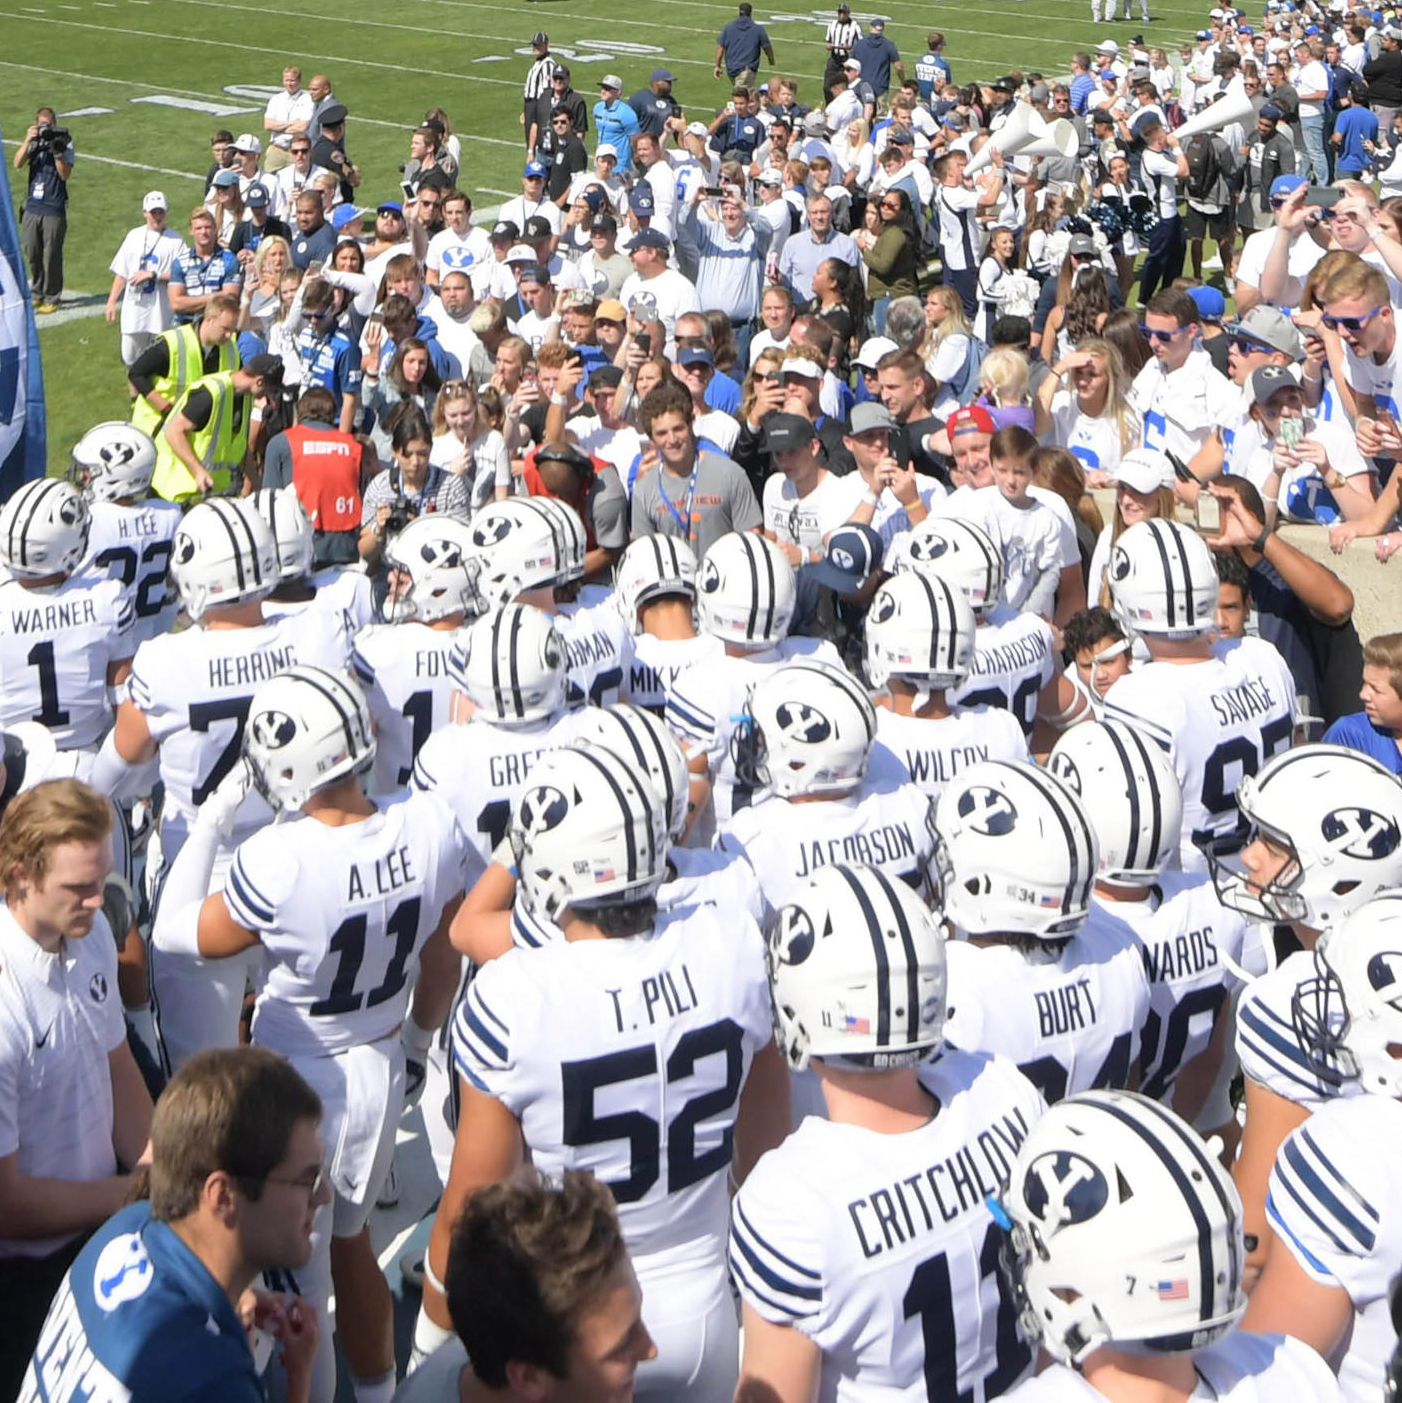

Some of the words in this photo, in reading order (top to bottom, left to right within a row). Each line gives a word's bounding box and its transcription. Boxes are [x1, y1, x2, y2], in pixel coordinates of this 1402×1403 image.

[302, 439, 350, 456] ESPN
[335, 497, 354, 514] 61
[11, 599, 97, 635] WARNER
[27, 640, 70, 727] 1
[209, 644, 299, 688] HERRING
[1211, 676, 1277, 727] SAVAGE
[349, 863, 372, 901] A.
[377, 847, 416, 894] LEE
[309, 894, 422, 1017] 11
[605, 987, 639, 1032] T.
[643, 964, 699, 1025] PILI
[1035, 980, 1098, 1038] BURT
[559, 1016, 745, 1205] 52
[848, 1107, 1030, 1259] CRITCHLOW
